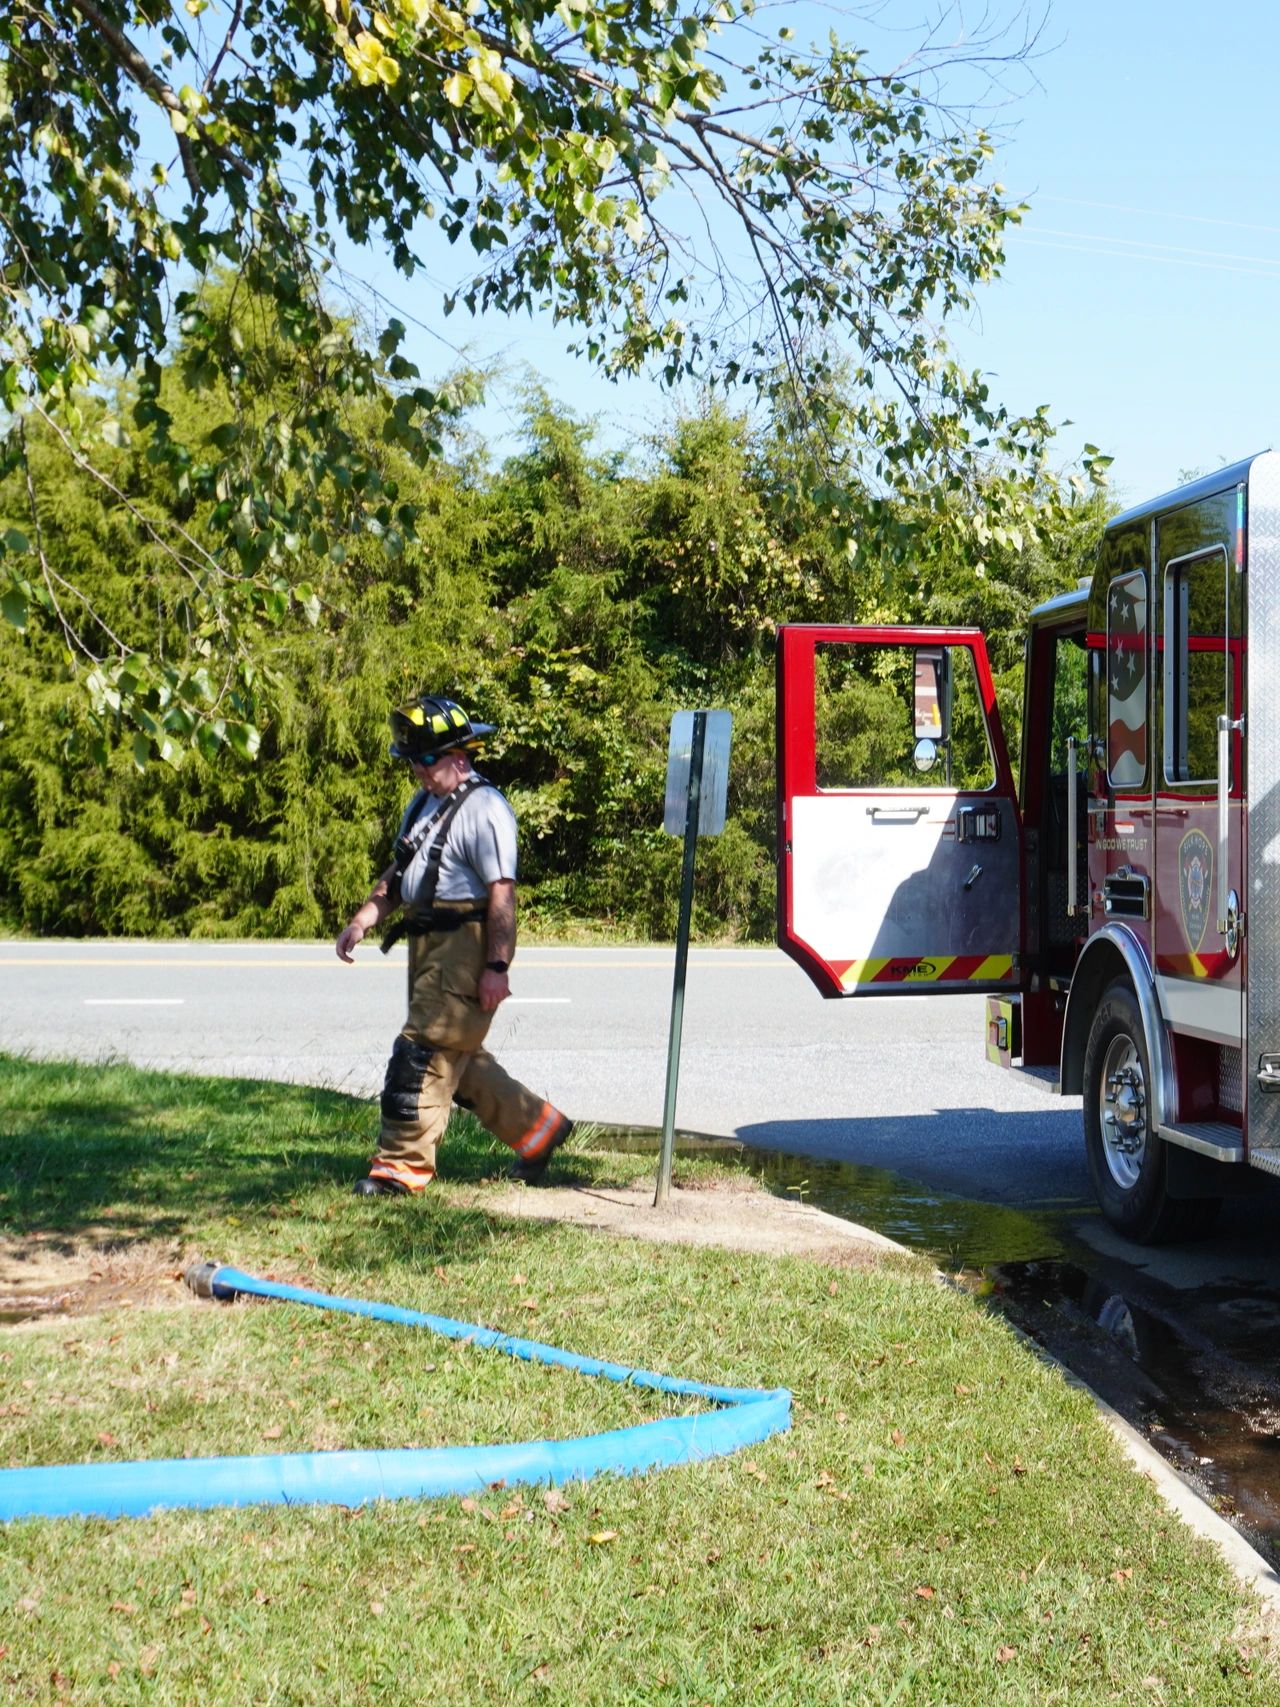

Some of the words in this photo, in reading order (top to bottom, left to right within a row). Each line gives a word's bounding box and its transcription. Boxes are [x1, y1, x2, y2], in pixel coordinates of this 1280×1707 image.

[1096, 839, 1102, 850] IN
[1102, 839, 1115, 850] GOD
[1116, 839, 1126, 850] WE
[1127, 839, 1147, 850] TRUST
